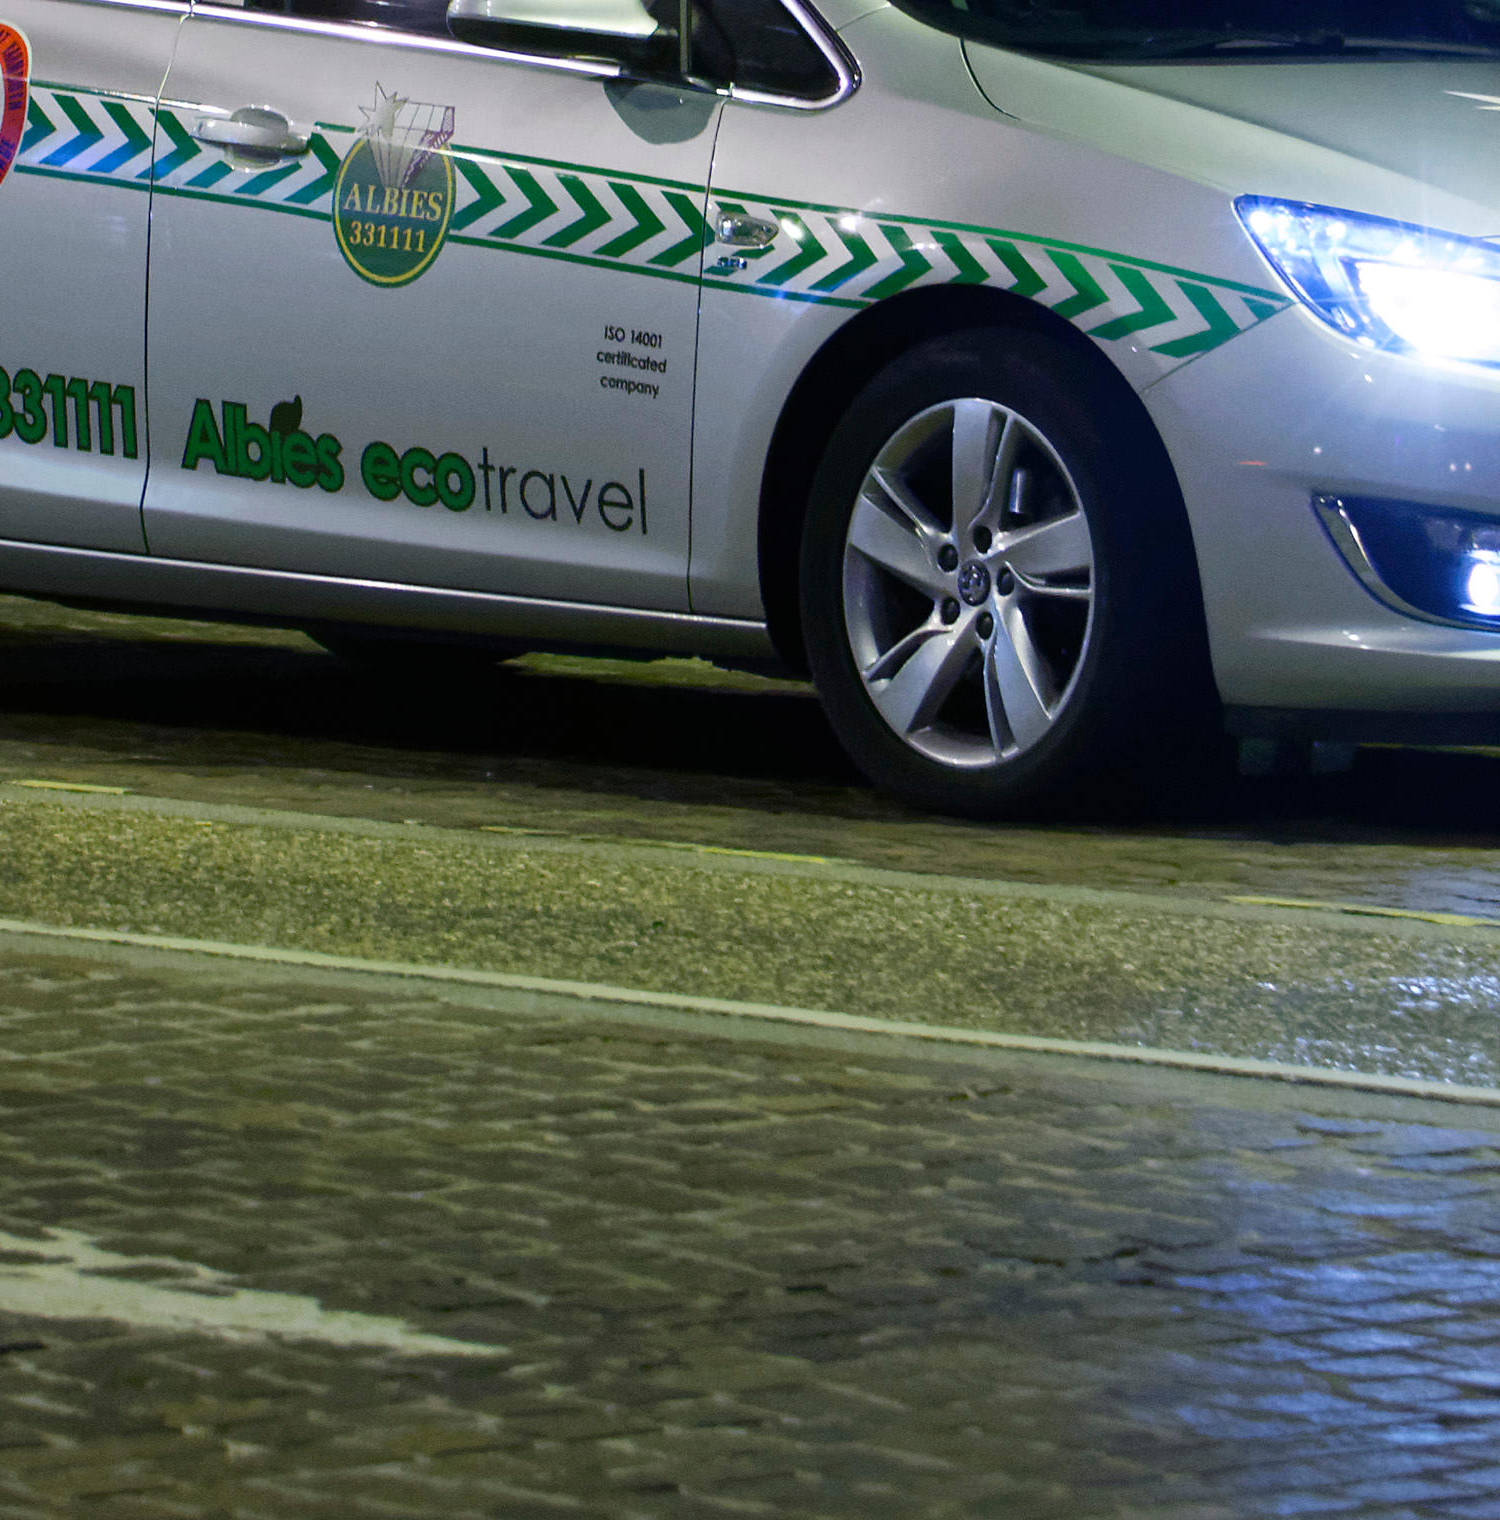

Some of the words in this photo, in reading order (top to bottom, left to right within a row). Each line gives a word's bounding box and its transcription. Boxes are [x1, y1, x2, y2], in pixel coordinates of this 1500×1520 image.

[343, 182, 444, 222] ALBIES
[349, 220, 426, 254] 331111
[604, 324, 626, 343] ISO
[630, 329, 662, 350] 14001
[596, 350, 667, 374] certificated
[600, 375, 660, 400] company
